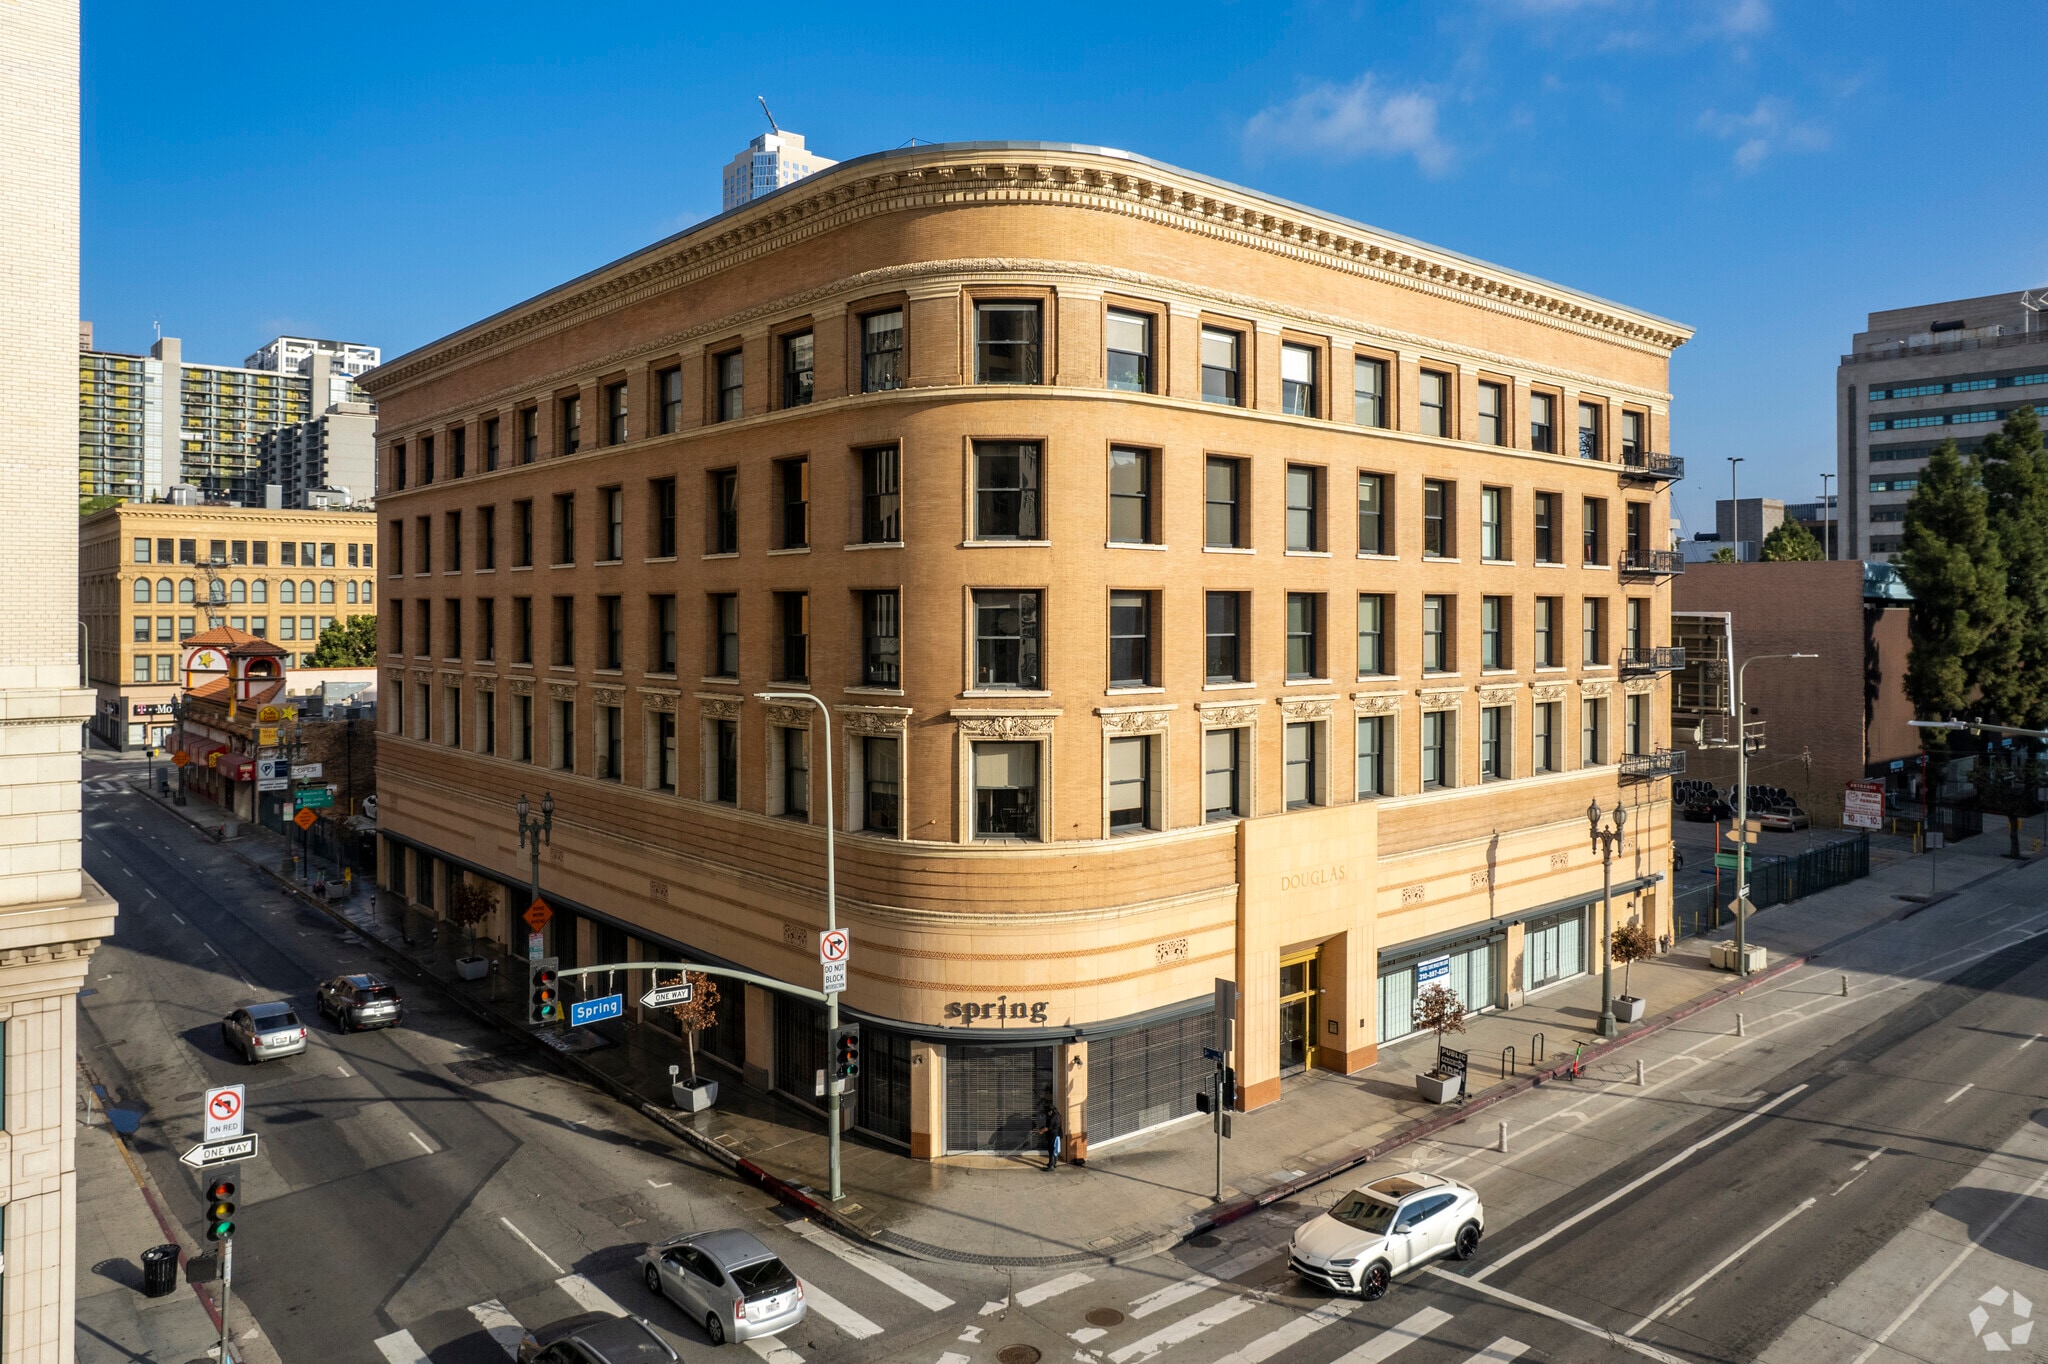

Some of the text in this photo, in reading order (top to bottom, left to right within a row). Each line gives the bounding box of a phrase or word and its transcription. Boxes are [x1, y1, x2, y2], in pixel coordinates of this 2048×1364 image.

[1281, 865, 1345, 891] DOUGLAS
[825, 963, 844, 974] DO NOT
[825, 974, 845, 983] BLOCK
[655, 990, 687, 1002] ONE WAY
[577, 1001, 617, 1019] Spring
[946, 995, 1049, 1024] spring
[1441, 1047, 1467, 1060] PUBLIC
[210, 1122, 238, 1134] ON RED
[204, 1142, 249, 1158] ONE WAY
